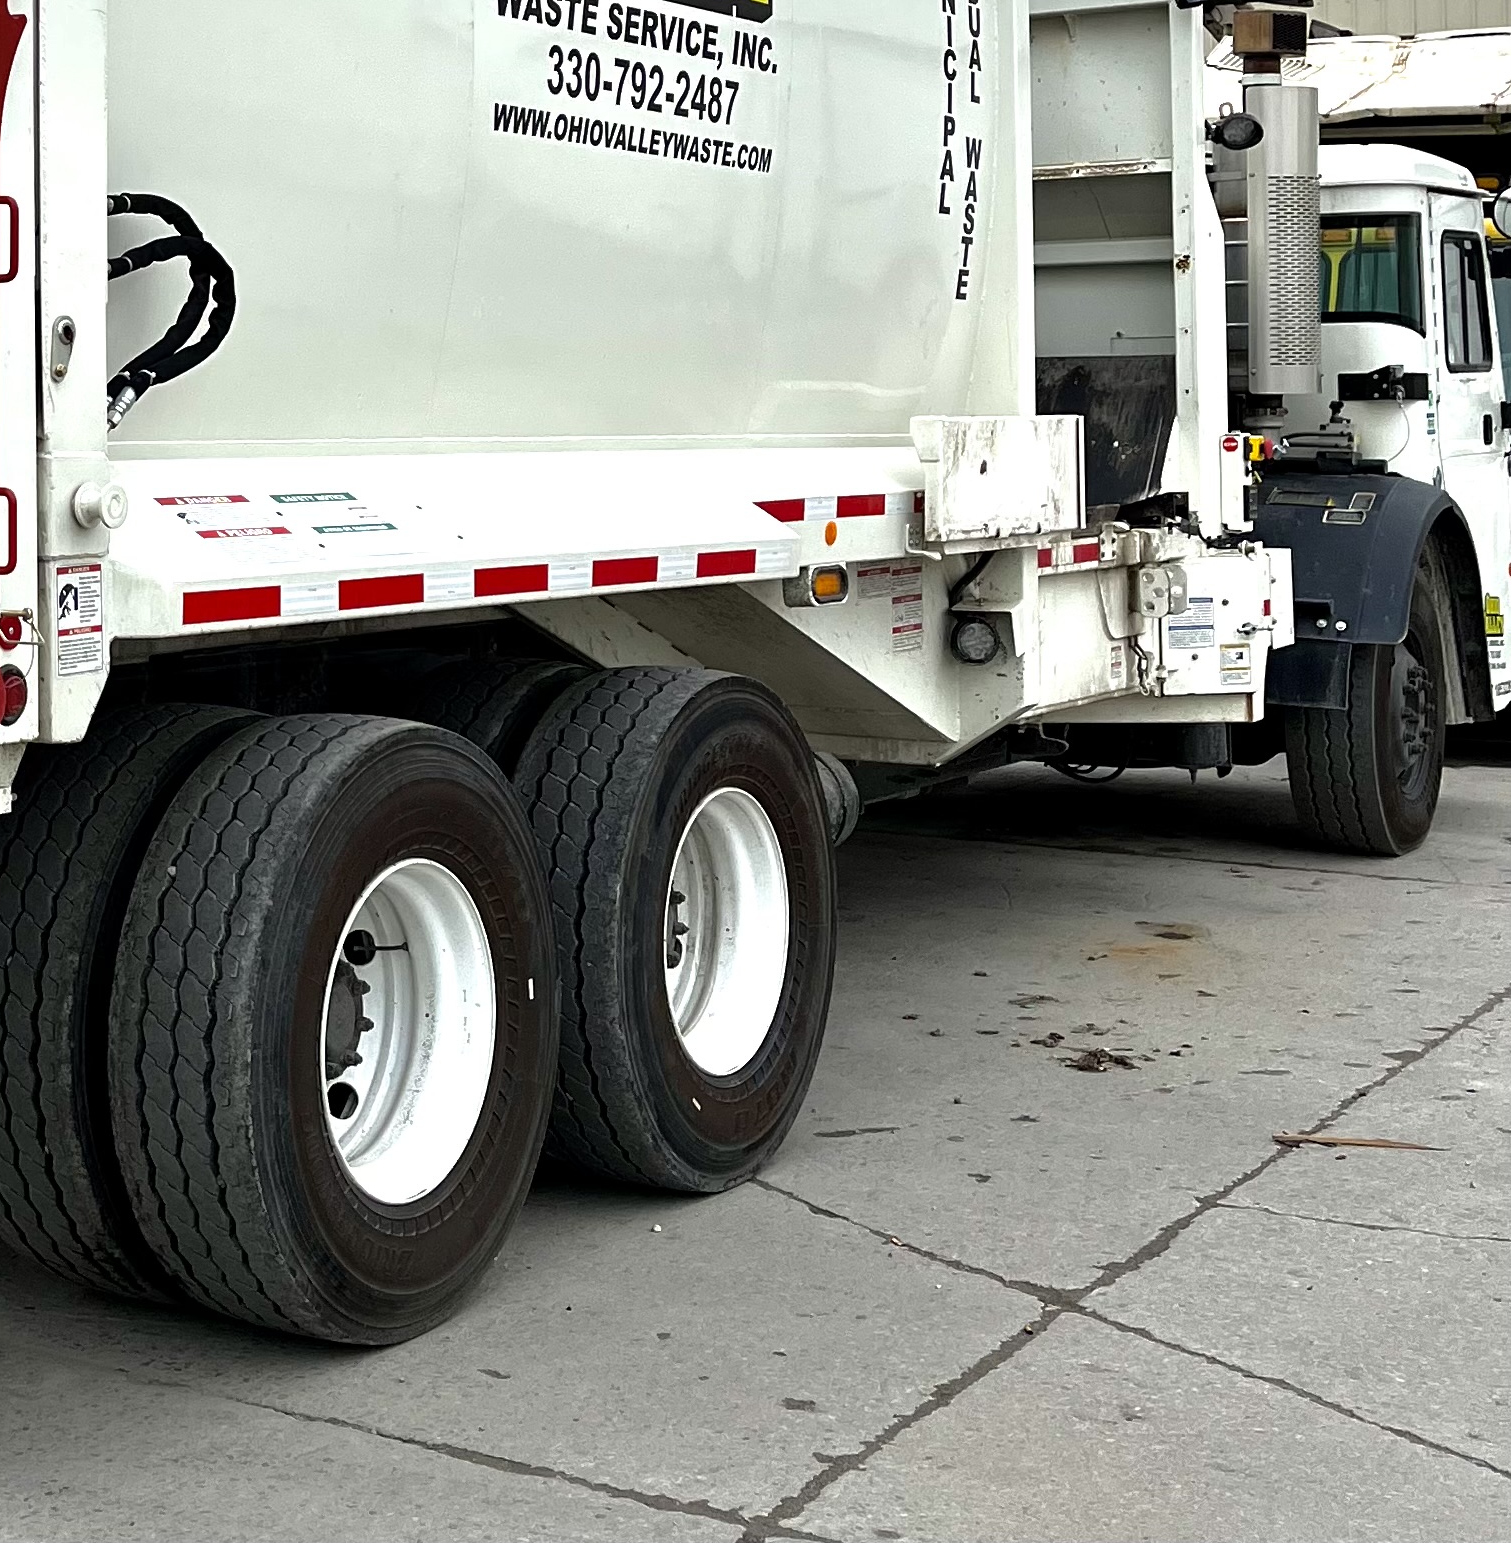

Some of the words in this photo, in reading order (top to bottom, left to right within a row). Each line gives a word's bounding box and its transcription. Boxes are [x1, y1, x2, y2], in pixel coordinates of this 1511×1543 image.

[606, 2, 725, 70] SERVICE,
[731, 30, 778, 74] INC.
[546, 43, 740, 126] 330-792-2487
[493, 102, 773, 174] WWW.OHIOVALLEYWASTE.COM
[954, 135, 983, 301] WASTE
